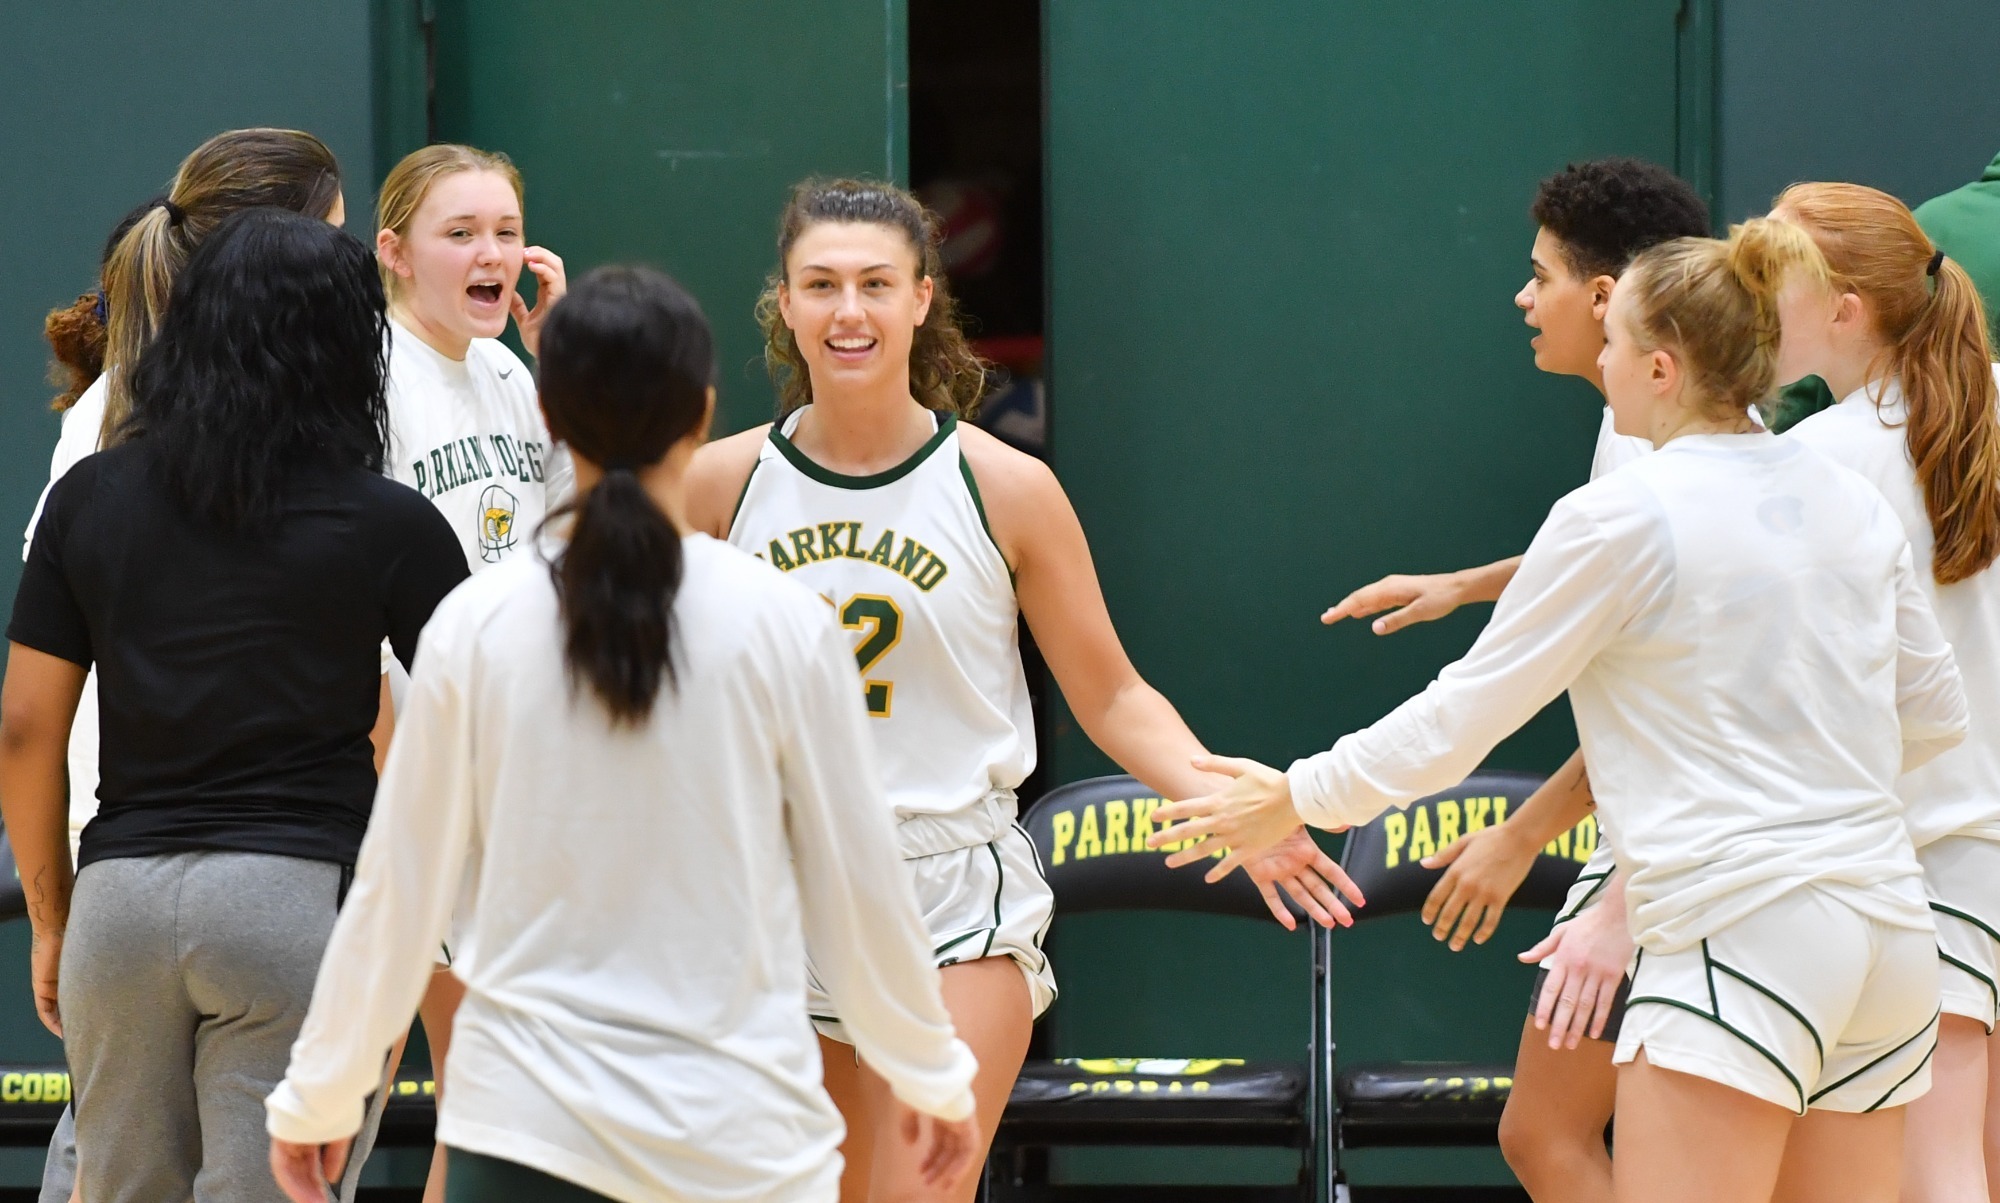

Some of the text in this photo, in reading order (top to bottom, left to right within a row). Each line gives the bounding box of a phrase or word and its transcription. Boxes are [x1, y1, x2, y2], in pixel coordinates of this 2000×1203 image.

[754, 521, 948, 593] ARKLAND
[819, 592, 904, 719] 2
[1052, 798, 1232, 866] PARKL
[1384, 796, 1597, 869] PARKLND
